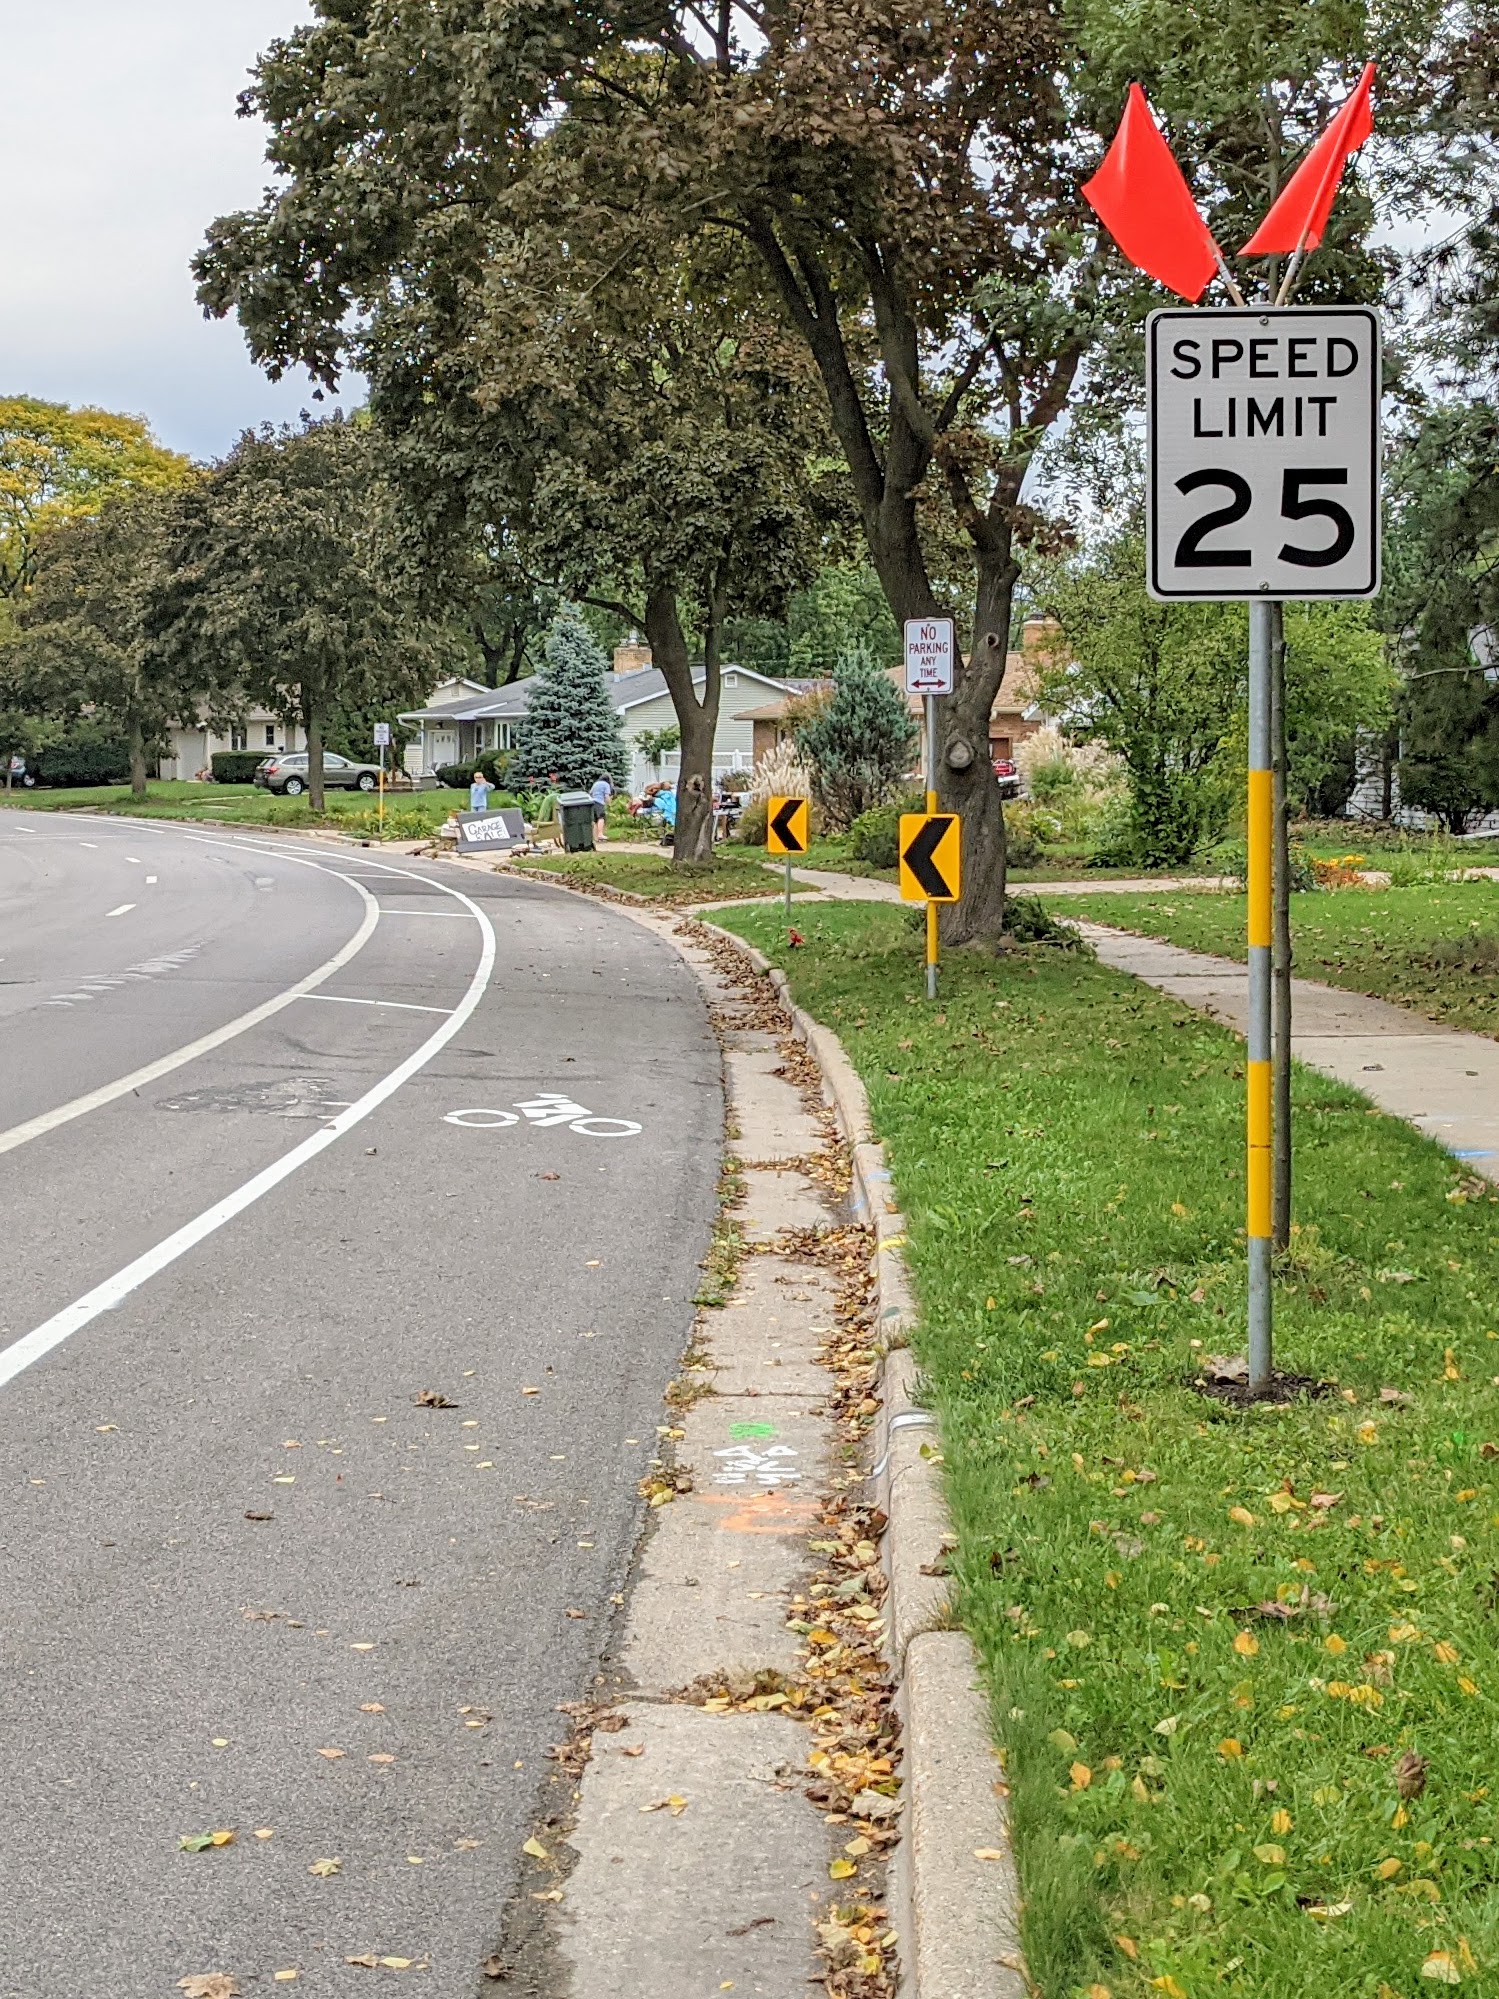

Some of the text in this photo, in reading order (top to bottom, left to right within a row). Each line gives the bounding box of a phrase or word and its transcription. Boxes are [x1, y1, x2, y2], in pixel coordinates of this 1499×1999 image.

[1170, 337, 1359, 379] SPEED
[1193, 396, 1337, 438] LIMIT
[1174, 467, 1355, 568] 25
[920, 626, 937, 640] NO
[908, 642, 949, 654] PARKING
[920, 656, 937, 666] ANY
[919, 667, 938, 677] TIME
[467, 821, 503, 836] GARAGE
